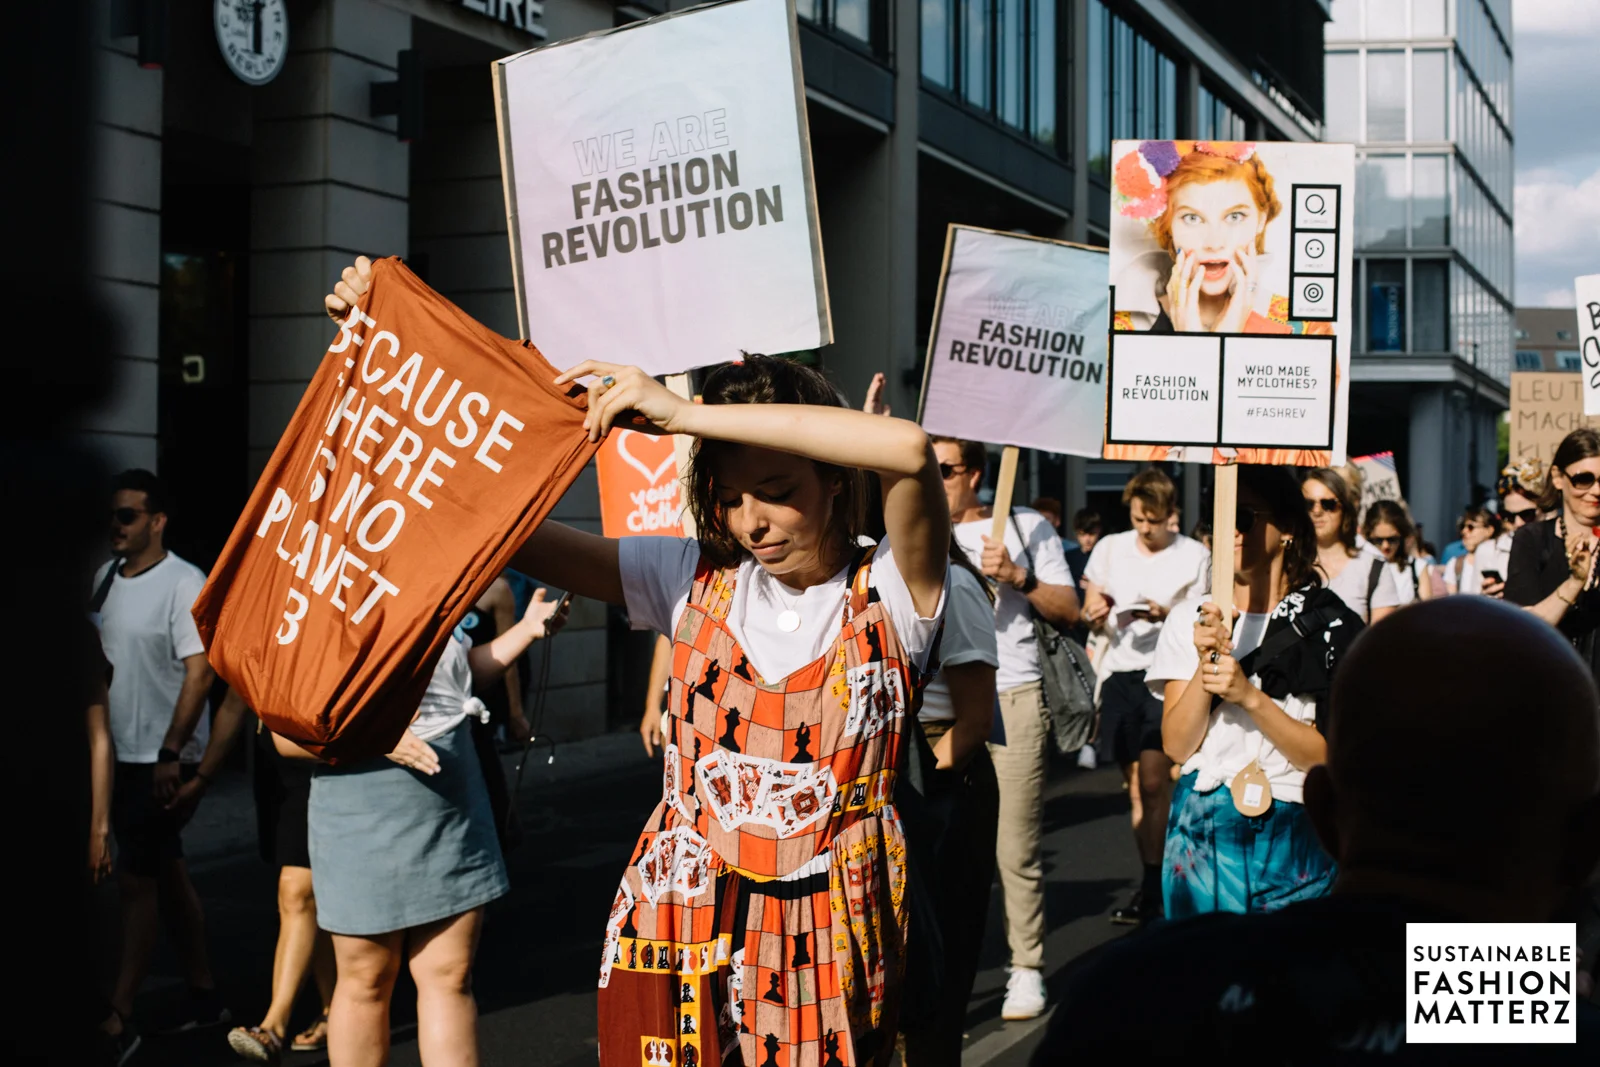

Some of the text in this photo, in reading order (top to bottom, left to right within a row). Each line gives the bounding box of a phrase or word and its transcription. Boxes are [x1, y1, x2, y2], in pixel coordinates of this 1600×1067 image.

[463, 0, 548, 39] RE
[573, 108, 730, 177] WE ARE
[572, 150, 740, 220] FASHION
[542, 184, 784, 269] REVOLUTION
[988, 293, 1085, 332] WE ARE
[978, 319, 1085, 356] FASHION
[949, 340, 1104, 384] REVOLUTION
[1135, 375, 1197, 388] FASHION
[1237, 377, 1318, 389] MY CLOTHES?
[1245, 365, 1311, 377] WHO MADE
[328, 305, 525, 473] BECAUSE
[1122, 388, 1209, 401] REVOLUTION
[1246, 407, 1307, 419] #FASHREV
[323, 371, 456, 510] HERE
[329, 472, 406, 553] NO
[256, 487, 400, 625] PLANET
[275, 587, 309, 645] B
